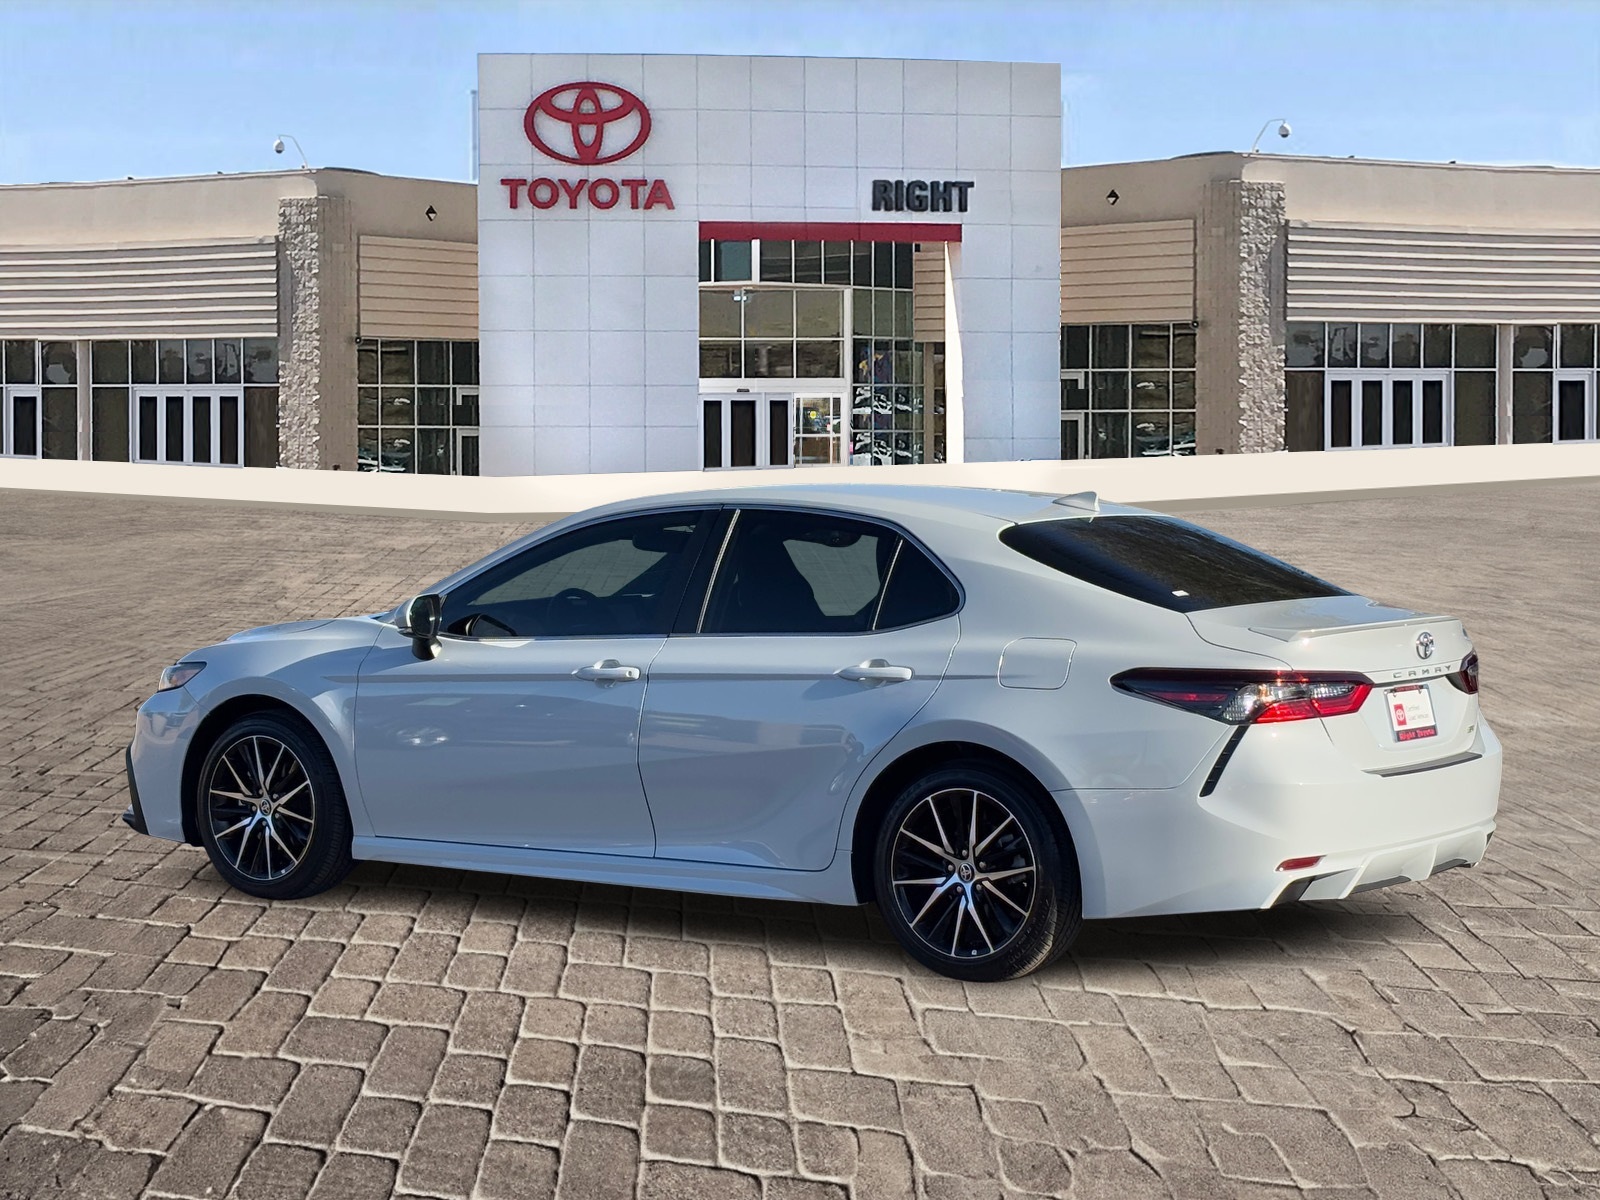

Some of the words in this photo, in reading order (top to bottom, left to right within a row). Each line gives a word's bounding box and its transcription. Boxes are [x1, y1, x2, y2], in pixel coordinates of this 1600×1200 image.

[500, 178, 675, 210] TOYOTA
[872, 180, 975, 212] RIGHT
[1393, 665, 1451, 678] CAMRY
